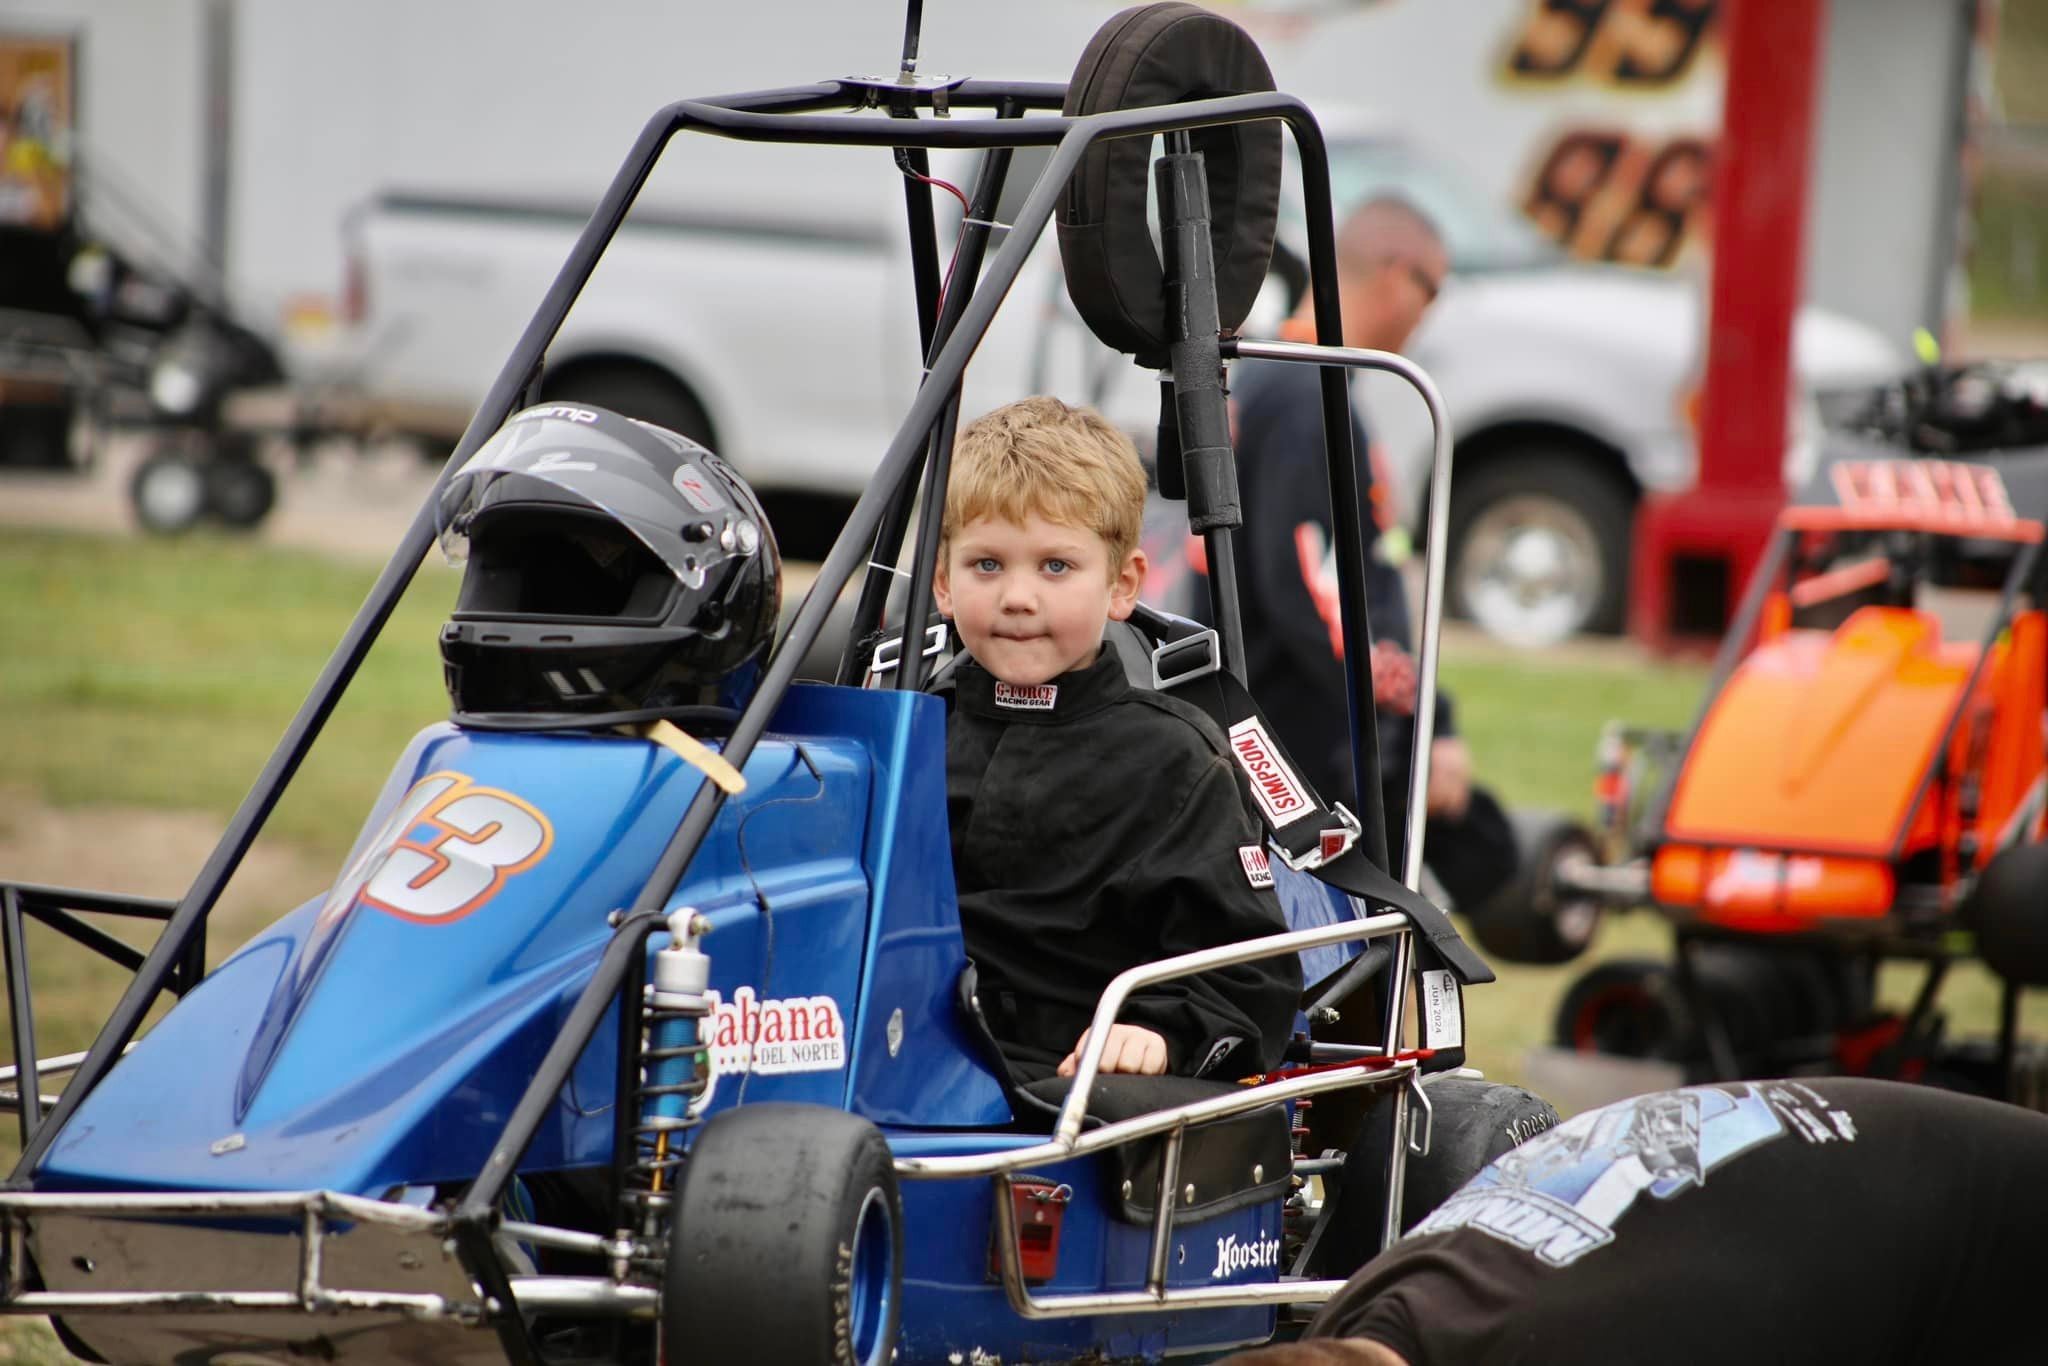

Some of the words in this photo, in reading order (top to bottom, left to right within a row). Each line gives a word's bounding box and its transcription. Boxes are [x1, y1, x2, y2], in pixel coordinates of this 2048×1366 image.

[996, 696, 1028, 705] RACING
[1235, 738, 1297, 809] SIMPSON
[1431, 984, 1440, 1006] JUN
[1433, 1009, 1442, 1033] 2024
[761, 1047, 787, 1065] DEL
[792, 1042, 840, 1064] NORTE
[1212, 1229, 1280, 1278] Hoosier
[832, 1242, 851, 1366] oosier
